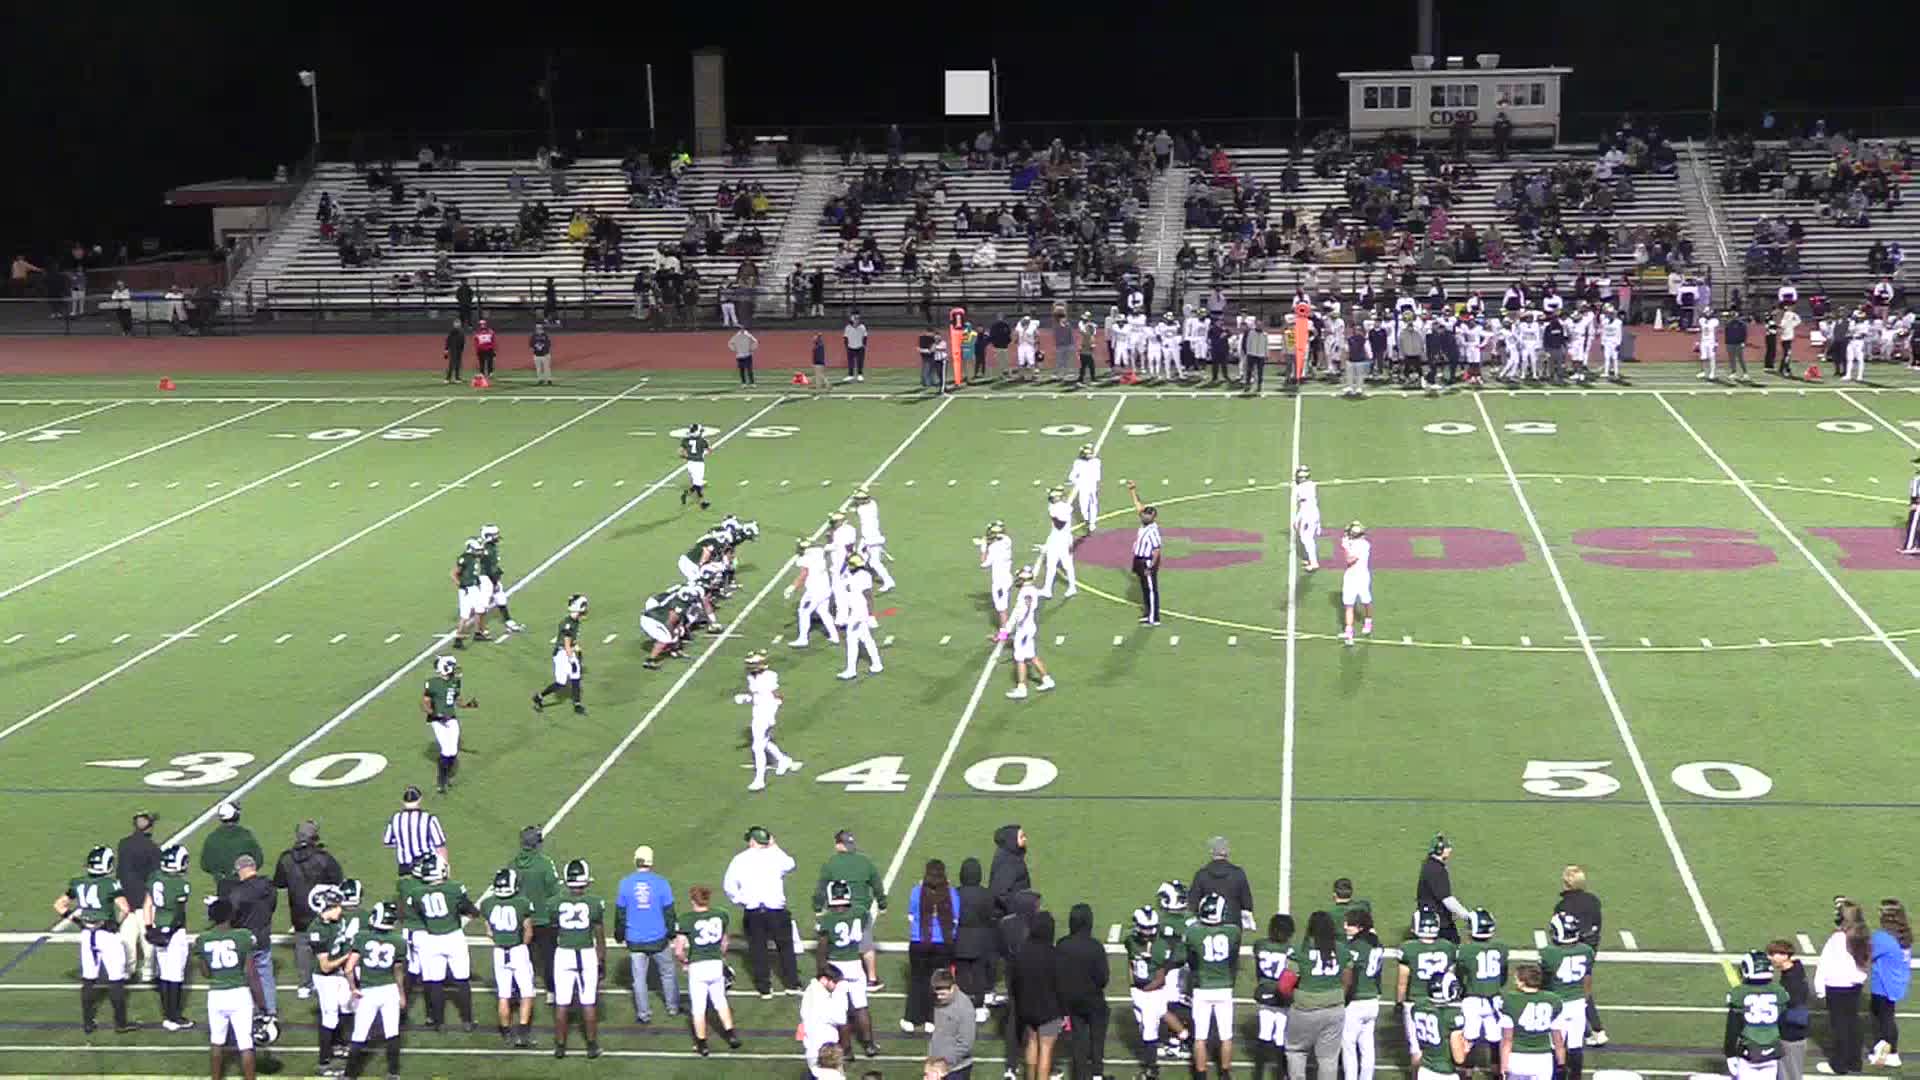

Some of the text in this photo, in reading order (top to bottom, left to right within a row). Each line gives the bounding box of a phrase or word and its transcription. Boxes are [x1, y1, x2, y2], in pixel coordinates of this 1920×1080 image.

[688, 438, 698, 454] 7
[144, 751, 388, 788] 30
[815, 755, 1058, 793] 40
[1521, 760, 1774, 798] 50
[76, 884, 102, 909] 14
[153, 881, 165, 907] 6
[422, 891, 449, 918] 10
[488, 905, 518, 932] 40
[558, 902, 590, 930] 23
[693, 916, 724, 947] 39
[834, 917, 863, 947] 34
[204, 939, 238, 969] 76
[363, 940, 396, 969] 33
[1202, 934, 1230, 962] 19
[1258, 950, 1288, 979] 27
[1475, 949, 1501, 979] 16
[1556, 955, 1587, 983] 45
[1743, 993, 1773, 1024] 35
[1414, 1011, 1441, 1046] 59
